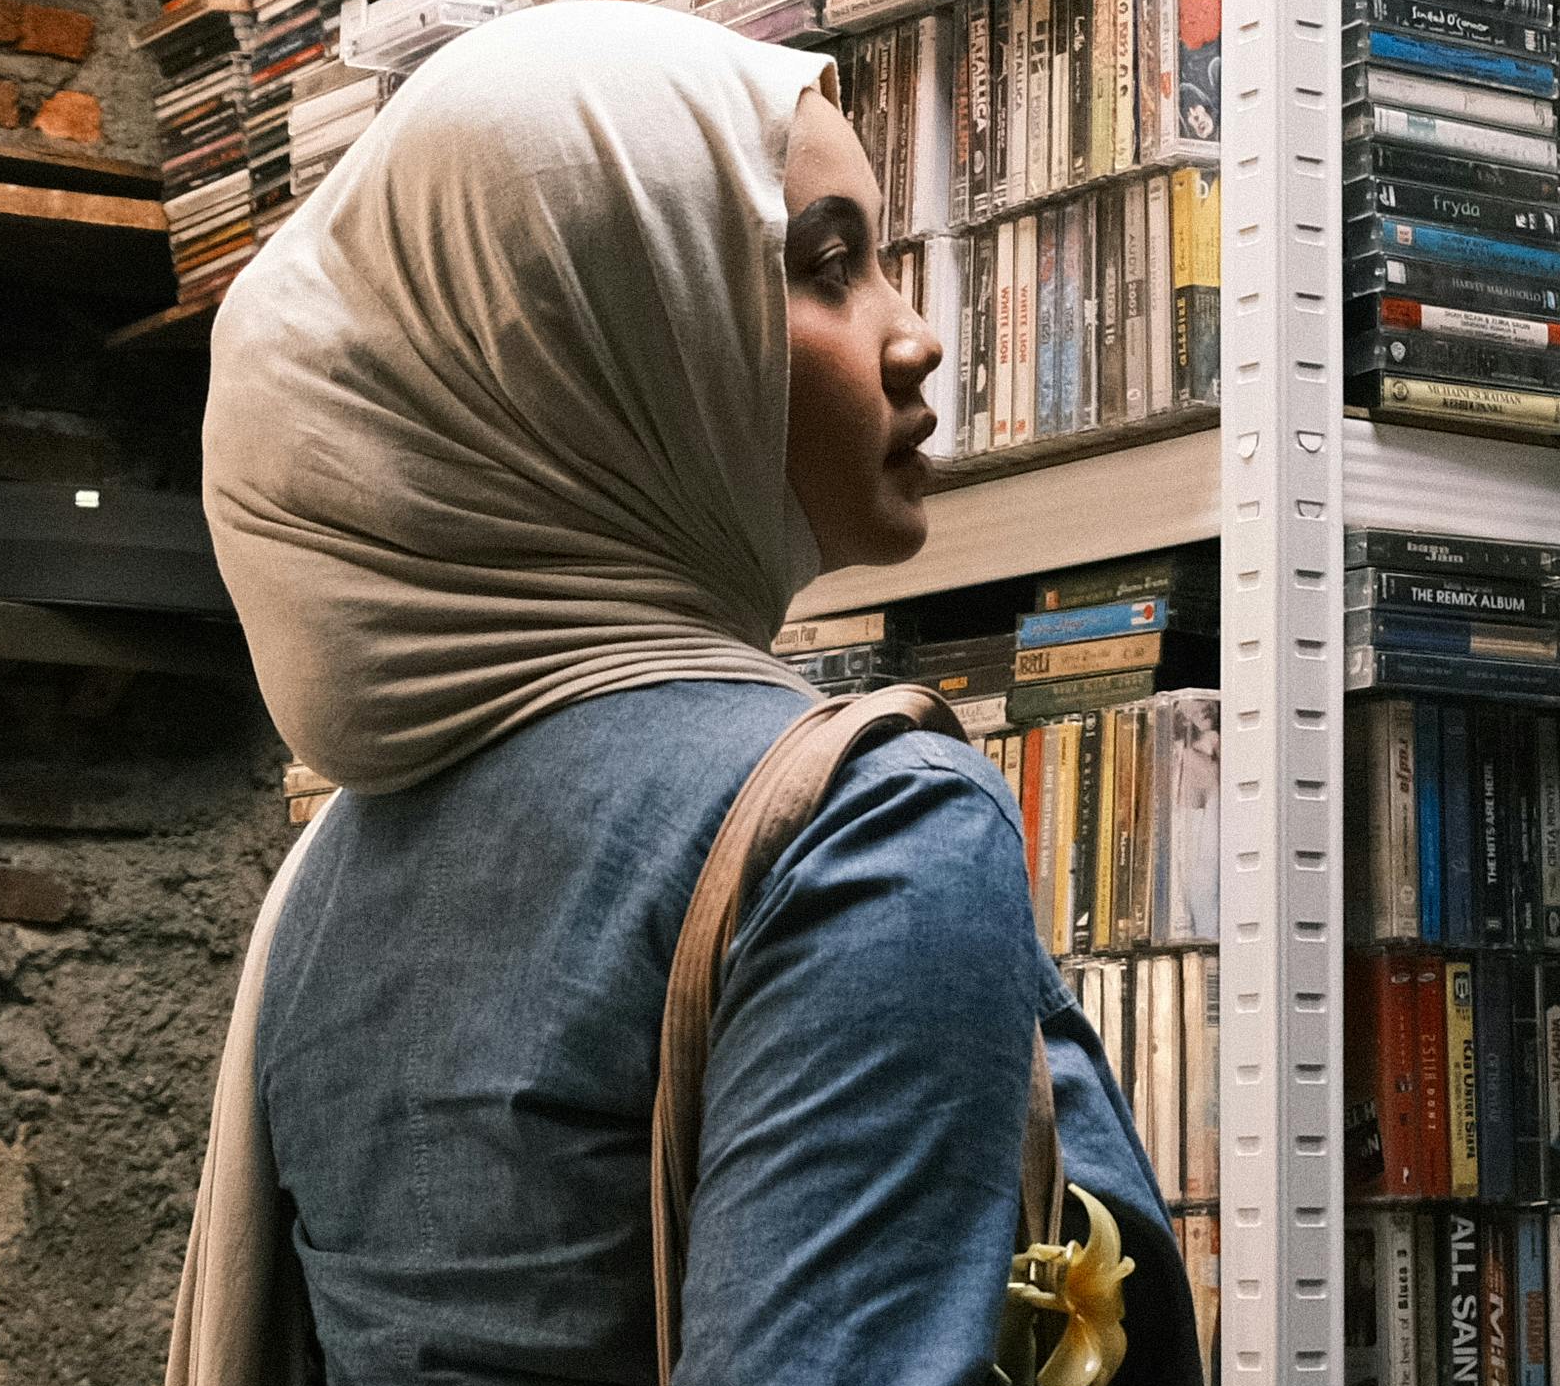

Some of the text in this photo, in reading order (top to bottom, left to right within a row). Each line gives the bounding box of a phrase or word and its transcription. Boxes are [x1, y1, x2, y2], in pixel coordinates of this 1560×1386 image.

[971, 18, 988, 133] METALLICA
[1411, 587, 1525, 611] THE REMIX ALBUM
[1041, 797, 1053, 846] MATTHEWS
[1450, 1215, 1475, 1286] ALL
